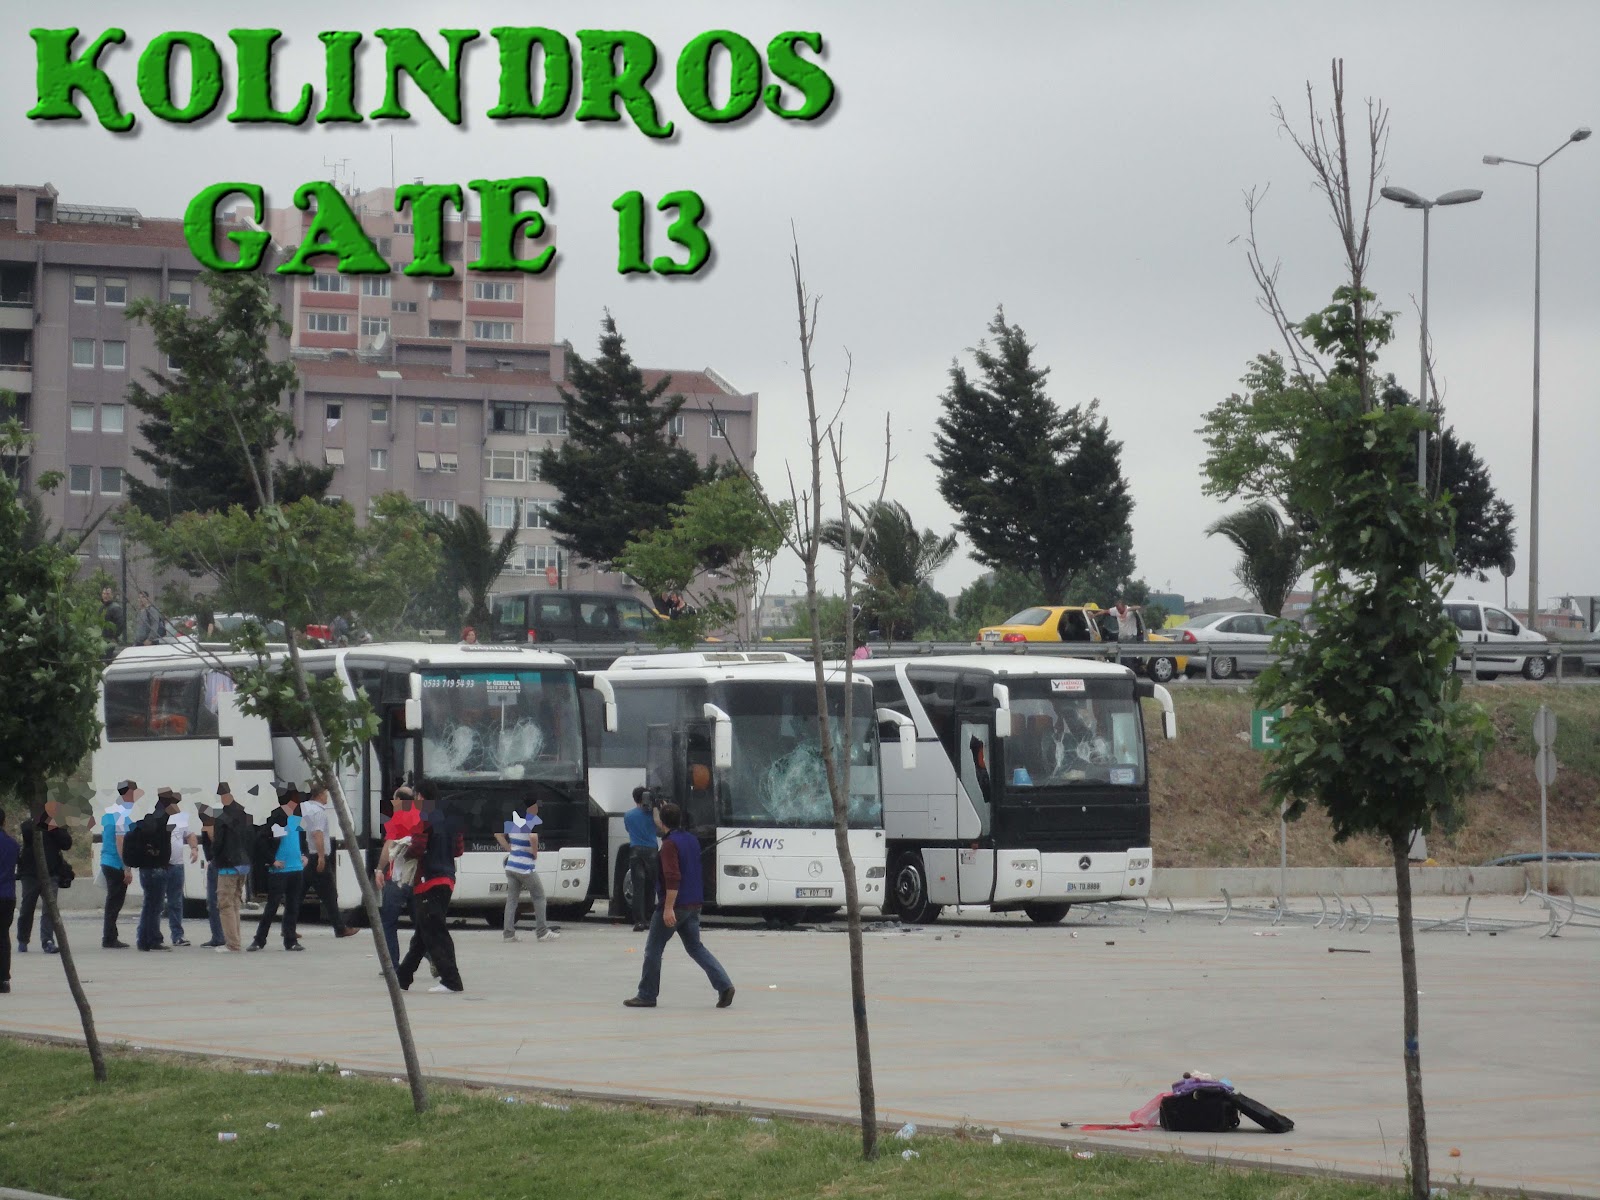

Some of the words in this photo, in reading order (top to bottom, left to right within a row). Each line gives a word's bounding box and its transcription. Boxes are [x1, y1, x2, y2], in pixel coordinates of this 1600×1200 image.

[1262, 716, 1275, 743] E
[472, 843, 505, 851] Mercede
[740, 837, 785, 850] HKN'S
